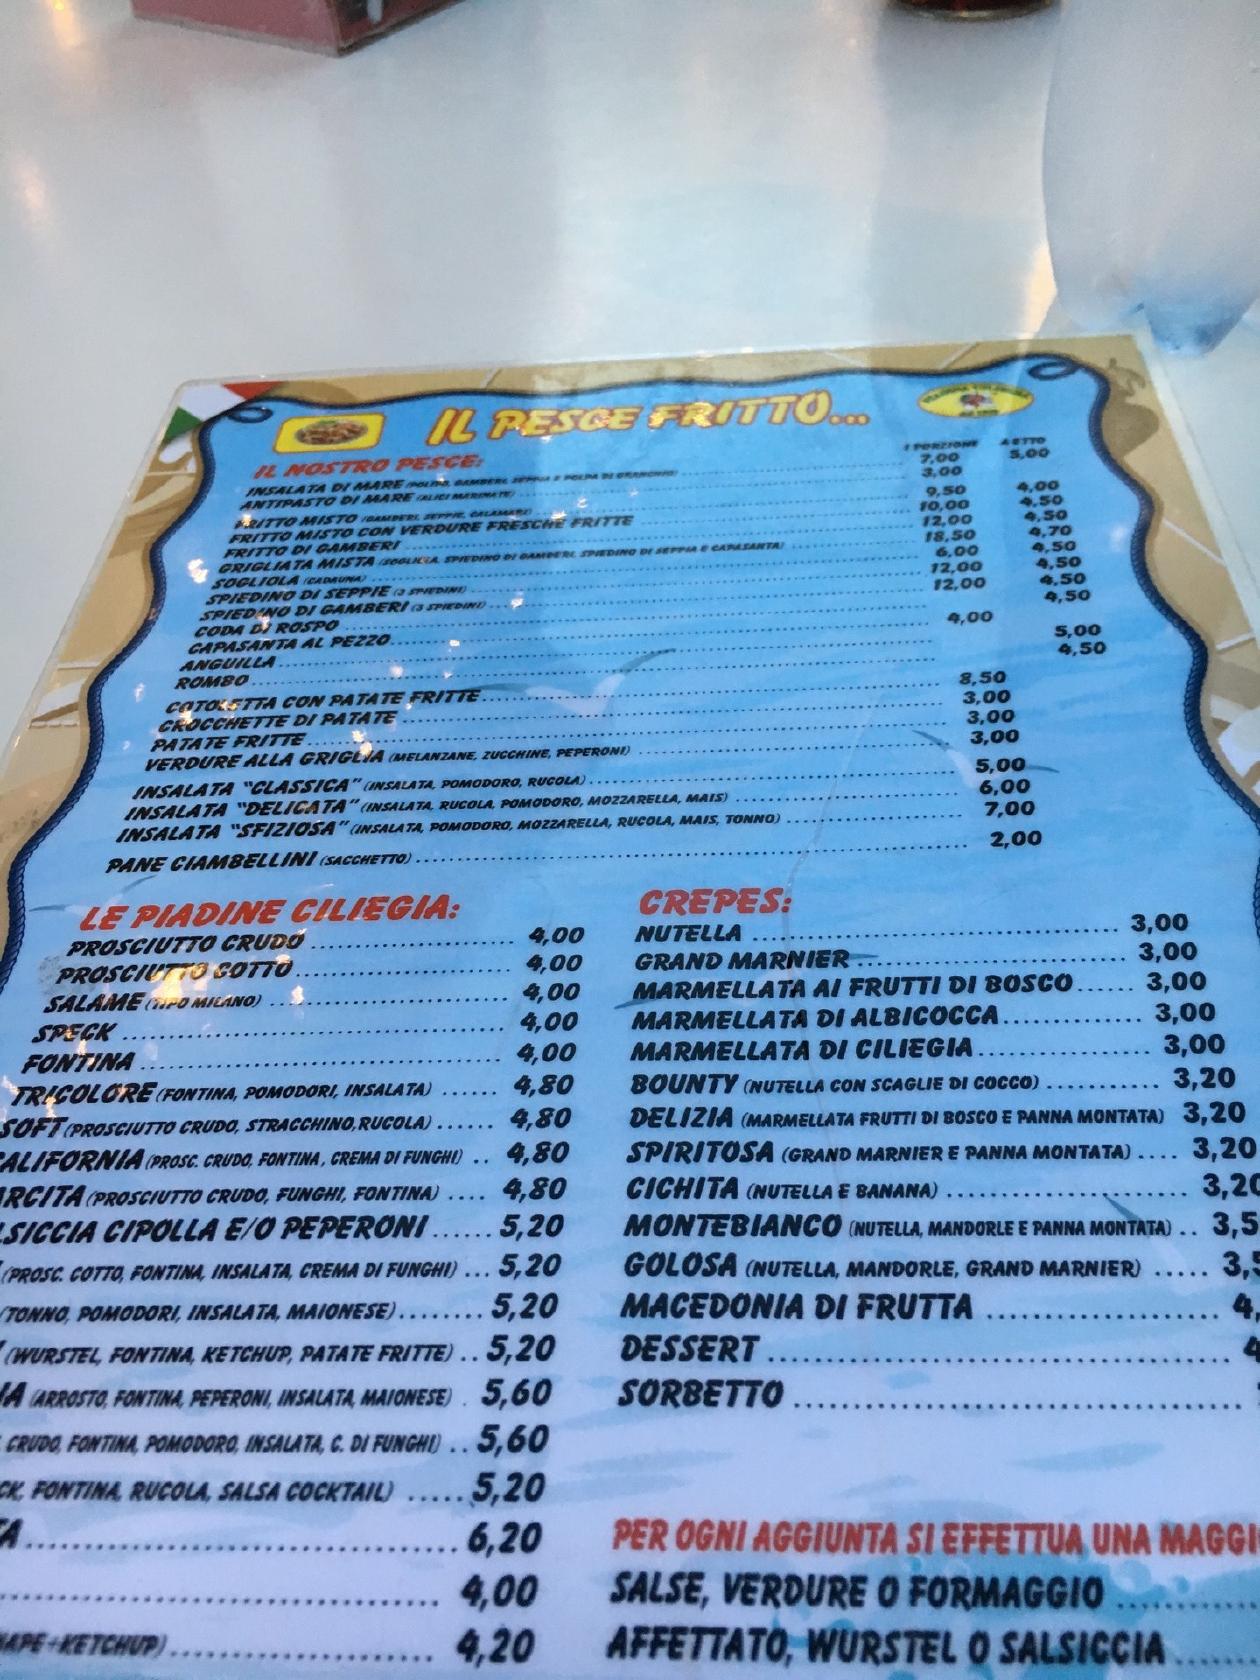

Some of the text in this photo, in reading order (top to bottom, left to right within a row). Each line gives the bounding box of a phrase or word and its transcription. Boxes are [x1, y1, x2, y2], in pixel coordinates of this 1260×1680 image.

[426, 408, 475, 446] IL
[488, 405, 643, 441] PESCE
[245, 483, 326, 498] INSALATA
[353, 479, 405, 492] MARE
[920, 452, 960, 465] 7,00
[253, 454, 484, 480] IL NOSTRO PESCE:
[240, 496, 337, 511] ANTIPASTO
[362, 492, 415, 505] MARE
[228, 515, 634, 545] FRITTO MISTO CON VERDURE FRESCHE FRITTE
[299, 513, 358, 527] MISTO
[223, 540, 402, 559] FRITTO GAMBERI
[217, 559, 314, 574] GRIGLIATA
[317, 556, 376, 570] MISTA
[205, 590, 296, 606] SPIEDINO
[323, 585, 391, 599] SEPPIE
[210, 576, 300, 590] SOGLIOLA
[320, 601, 410, 615] GAMBERI
[193, 620, 340, 638] CODA ROSPO
[187, 638, 298, 656] CAPASANTA
[179, 655, 277, 672] ANGUILLA
[174, 675, 249, 690] ROMBO
[282, 689, 482, 708] CON PATATE FRITTE
[320, 689, 1011, 727] PATATE 3,00
[150, 709, 1015, 752] PATATE FRITTE 3,00
[144, 729, 1020, 772] VERDURE ALLA 3,00
[132, 782, 235, 800] INSALATA
[975, 757, 1026, 775] 5,00
[124, 802, 228, 821] INSALATA
[979, 778, 1031, 796] 6,00
[115, 824, 221, 844] INSALATA
[984, 800, 1035, 818] 7,00
[105, 831, 1042, 875] PANE CIAMBELLINI 2,00
[79, 893, 461, 932] LE PIADINE CILIEGIA:
[638, 886, 793, 916] CREPES:
[66, 926, 586, 957] PROSCIUTTO CRUDO 4,00
[634, 913, 1189, 943] NUTELLA 3,00
[525, 953, 583, 975] 4,00
[635, 949, 851, 972] GRAND MARNIER
[633, 972, 1074, 1001] MARMELLATA FRUTTI BOSCO
[43, 991, 148, 1014] SALAME
[31, 1022, 119, 1044] SPECK
[631, 1005, 999, 1032] MARMELLATA ALBICOCCA
[20, 1050, 137, 1076] FONTINA
[630, 1037, 973, 1063] MARMELLATA CILIEGIA
[513, 1073, 575, 1098] 4,80
[630, 1066, 1237, 1096] BOUNTY CON 3,20
[510, 1106, 573, 1132] 4,80
[629, 1106, 1074, 1129] DELIZIA FRUTTI PANNA
[330, 1150, 382, 1167] CREMA
[506, 1140, 571, 1168] 4,80
[626, 1135, 1258, 1165] SPIRITOSA (GRAND MARNIER PANNA 3,20
[502, 1175, 568, 1204] 4,80
[626, 1175, 740, 1200] CICHITA
[746, 1182, 833, 1200] (NUTELLA
[855, 1181, 939, 1200] BANANA)
[103, 1217, 220, 1244] CIPOLLA
[281, 1214, 430, 1241] PEPERONI
[499, 1212, 565, 1242] 5,20
[623, 1213, 1086, 1238] MONTEBIANCO MANDORLE PANNA
[299, 1252, 562, 1280] CREMA 5,20
[624, 1251, 1142, 1279] GOLOSA GRAND MARNIER)
[286, 1291, 560, 1323] MAIONESE) 5,20
[620, 1291, 974, 1321] MACEDONIA FRUTTA
[299, 1342, 455, 1364] PATATE FRITTE)
[620, 1333, 762, 1364] DESSERT
[480, 1378, 553, 1411] 5,60
[617, 1378, 785, 1410] SORBETTO
[476, 1423, 550, 1458] 5,60
[218, 1480, 282, 1503] SALSA
[467, 1520, 543, 1559] 6,20
[612, 1517, 1260, 1557] PER OGNI AGGIUNTA SI EFFETTUA UNA MAGGI
[460, 1573, 539, 1613] 4,00
[609, 1570, 1105, 1612] SALSE, VERDURE FORMAGGIO
[455, 1626, 536, 1669] 4,20
[806, 1627, 1166, 1667] WURSTEL SALSICCIA
